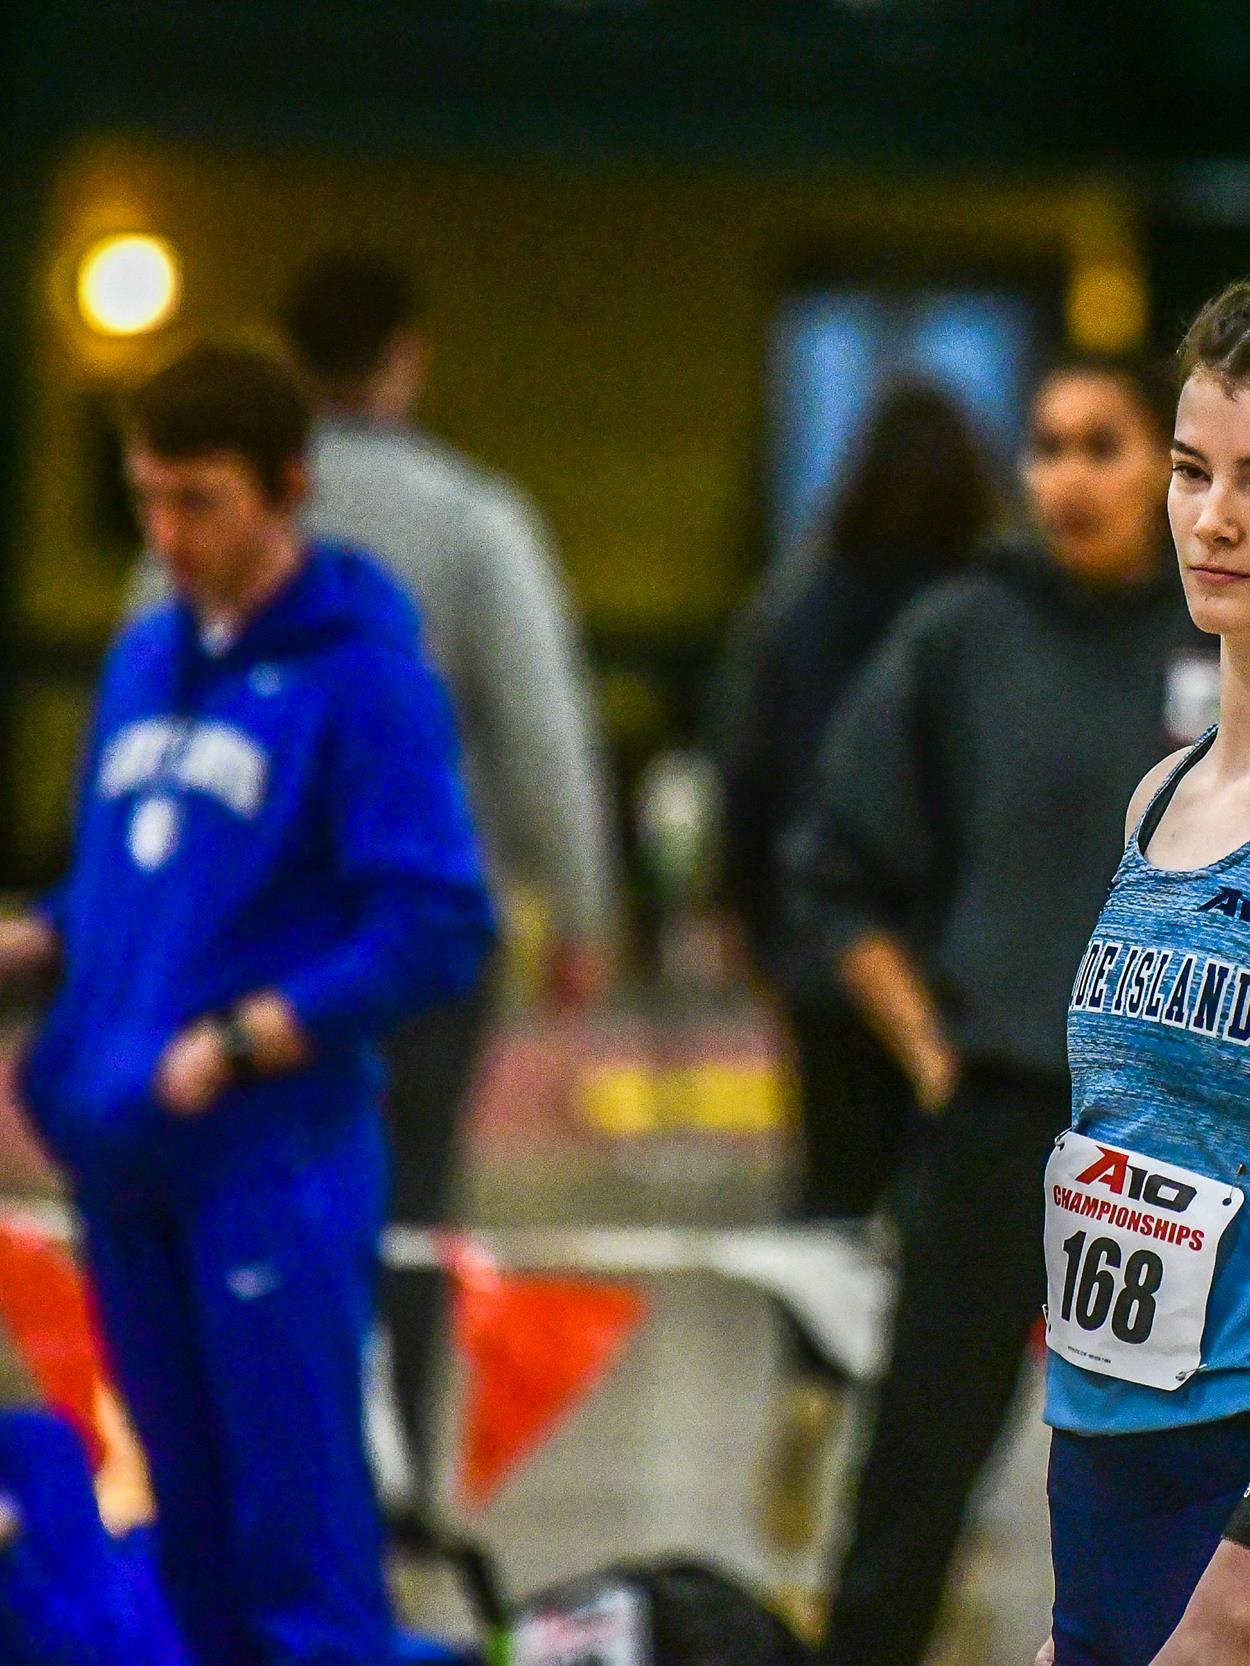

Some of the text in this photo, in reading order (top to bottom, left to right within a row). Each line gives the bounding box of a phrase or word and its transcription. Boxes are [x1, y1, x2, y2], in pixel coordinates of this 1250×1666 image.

[1068, 940, 1123, 1012] DE
[1075, 1145, 1197, 1213] A10
[1053, 1185, 1205, 1251] CHAMPIONSHIPS
[1061, 1230, 1164, 1344] 168
